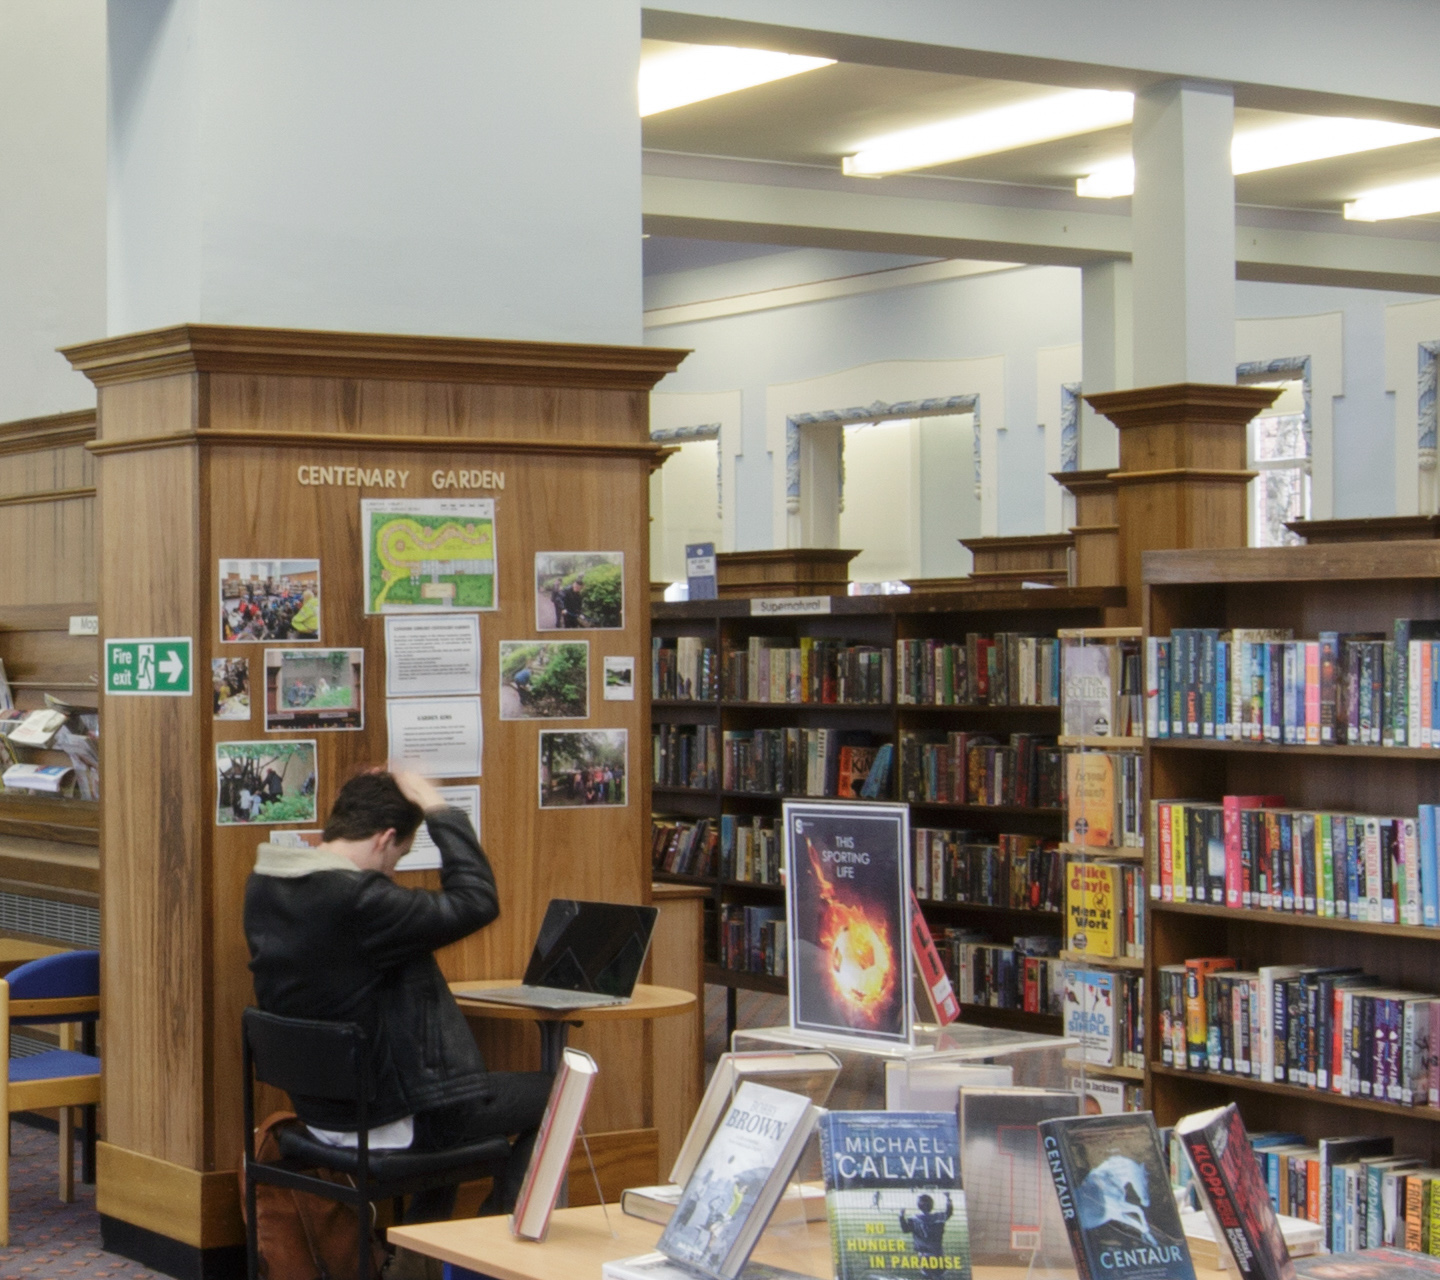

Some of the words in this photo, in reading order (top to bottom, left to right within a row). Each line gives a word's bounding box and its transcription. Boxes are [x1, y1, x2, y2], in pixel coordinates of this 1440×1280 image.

[297, 465, 410, 488] CENTENARY
[432, 470, 505, 490] GARDEN
[113, 649, 132, 665] Fire
[113, 670, 132, 686] exit
[835, 836, 854, 848] THIS
[822, 851, 870, 865] SPORTING
[836, 867, 854, 879] LIFE
[1074, 865, 1107, 880] Mike
[1070, 877, 1110, 893] Gayle
[1071, 905, 1095, 917] Men
[1100, 908, 1111, 919] at
[1076, 916, 1109, 930] Work
[1072, 1011, 1106, 1025] DEAD
[1068, 1020, 1110, 1037] SIMPLE
[1092, 1081, 1119, 1094] Jackson
[725, 1108, 788, 1141] BROWN
[846, 1137, 945, 1154] MICHAEL
[839, 1155, 956, 1179] CALVIN
[1191, 1144, 1226, 1199] KLOPP
[1044, 1136, 1075, 1220] CENTAUR
[1407, 1183, 1420, 1217] FRONT
[865, 1222, 885, 1235] NO
[847, 1239, 906, 1253] HUNGER
[870, 1256, 885, 1269] IN
[891, 1256, 962, 1270] PARADISE
[1100, 1245, 1183, 1270] CENTAUR
